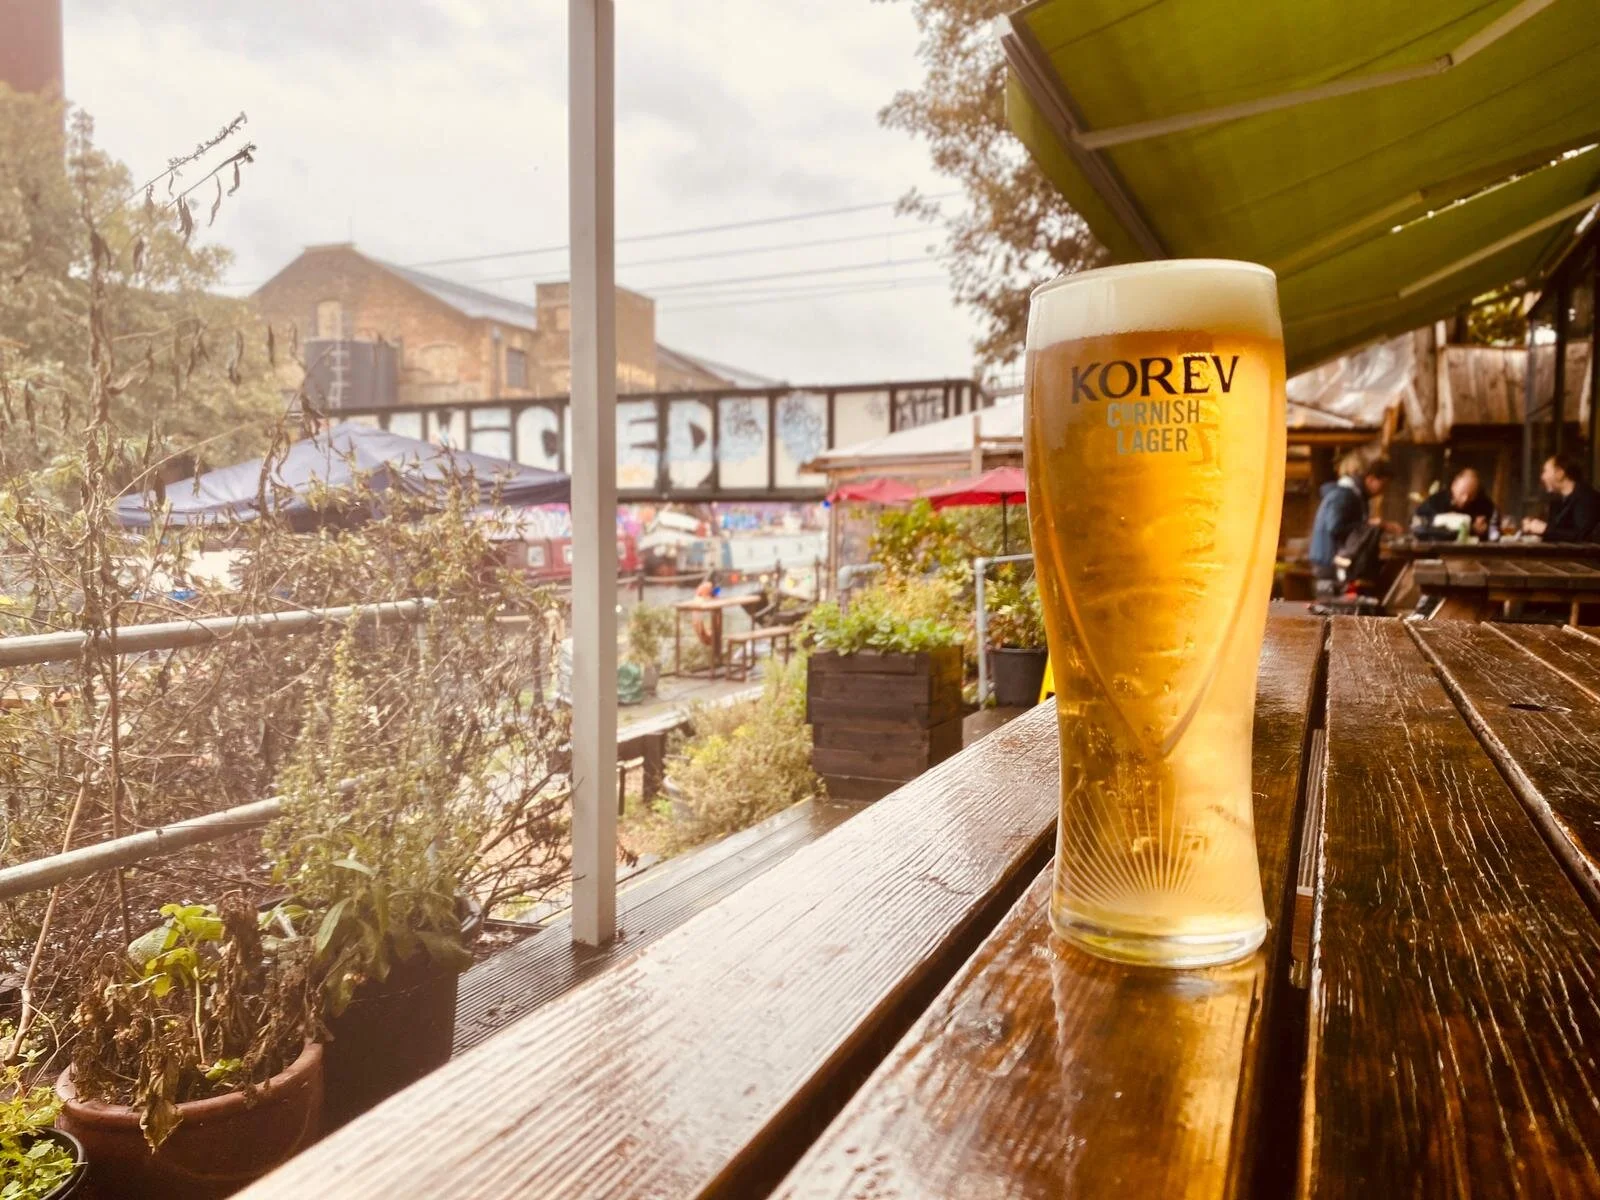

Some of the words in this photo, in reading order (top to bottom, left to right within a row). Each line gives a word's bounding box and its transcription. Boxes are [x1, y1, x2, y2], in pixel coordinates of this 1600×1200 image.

[1070, 355, 1239, 404] KOREV
[1107, 400, 1200, 428] CORNISH
[1117, 428, 1188, 455] LAGER
